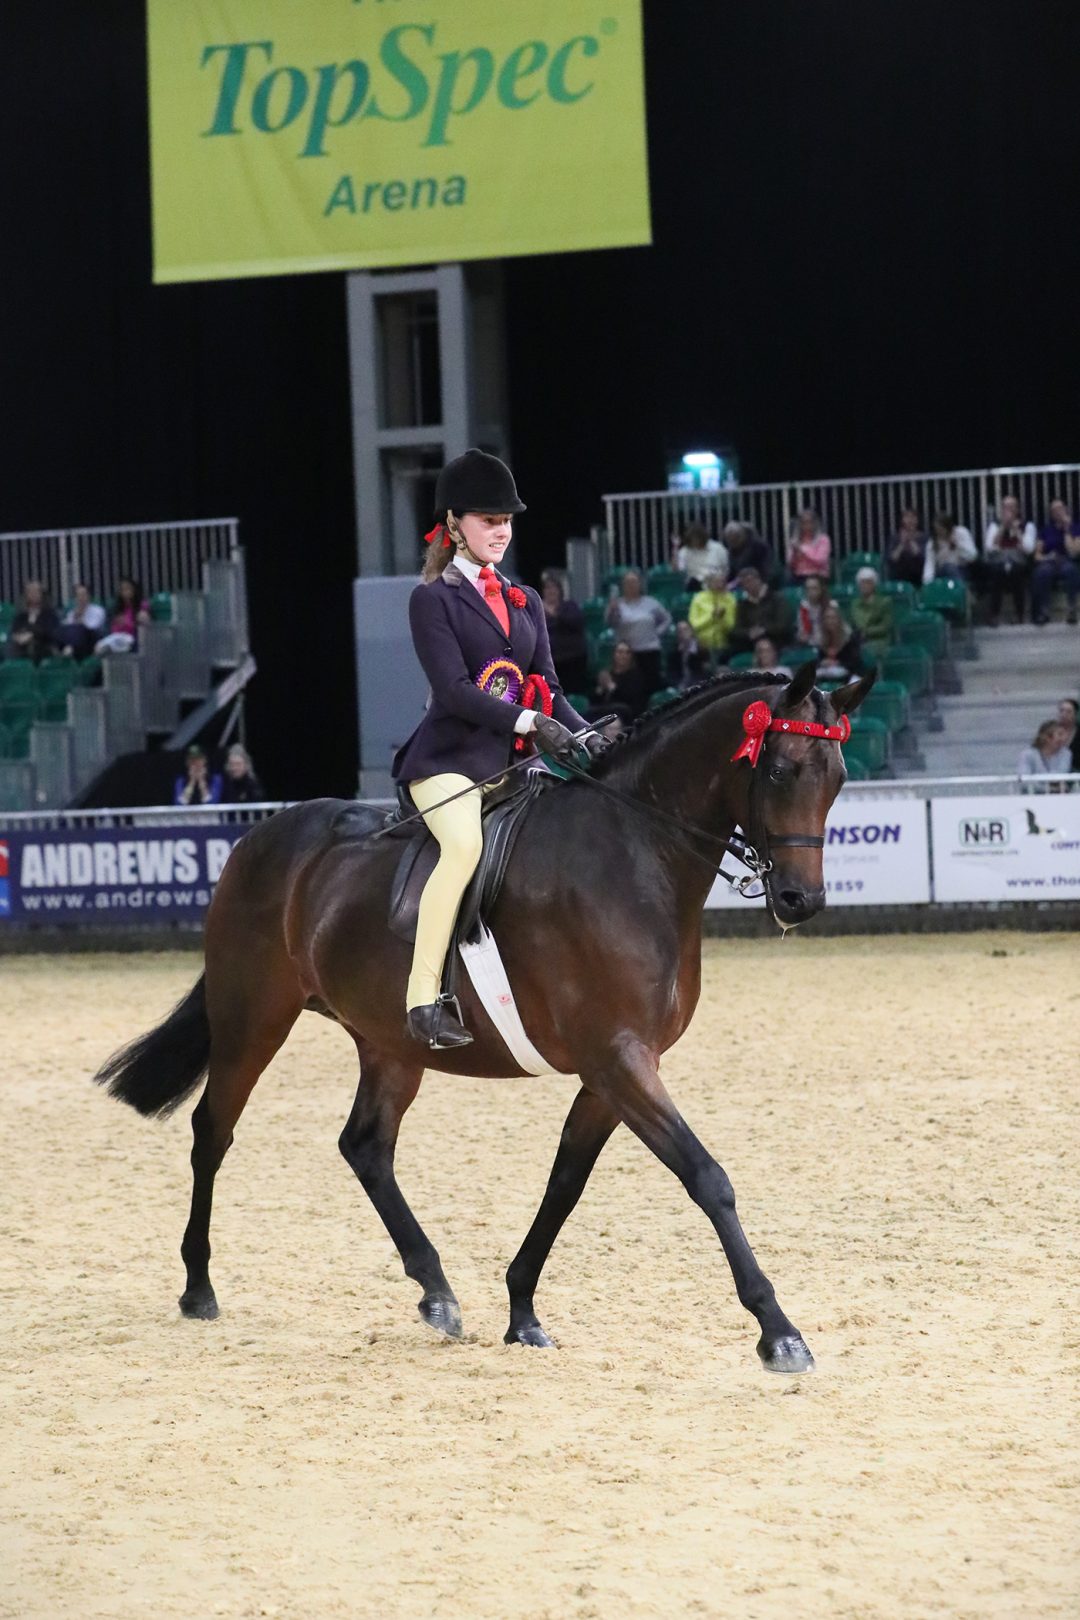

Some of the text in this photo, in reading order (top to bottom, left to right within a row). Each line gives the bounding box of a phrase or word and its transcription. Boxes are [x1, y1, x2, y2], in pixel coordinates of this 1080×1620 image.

[200, 23, 600, 159] TopSpec
[323, 174, 468, 218] Arena
[825, 824, 901, 845] NSON
[20, 838, 200, 888] ANDREWS
